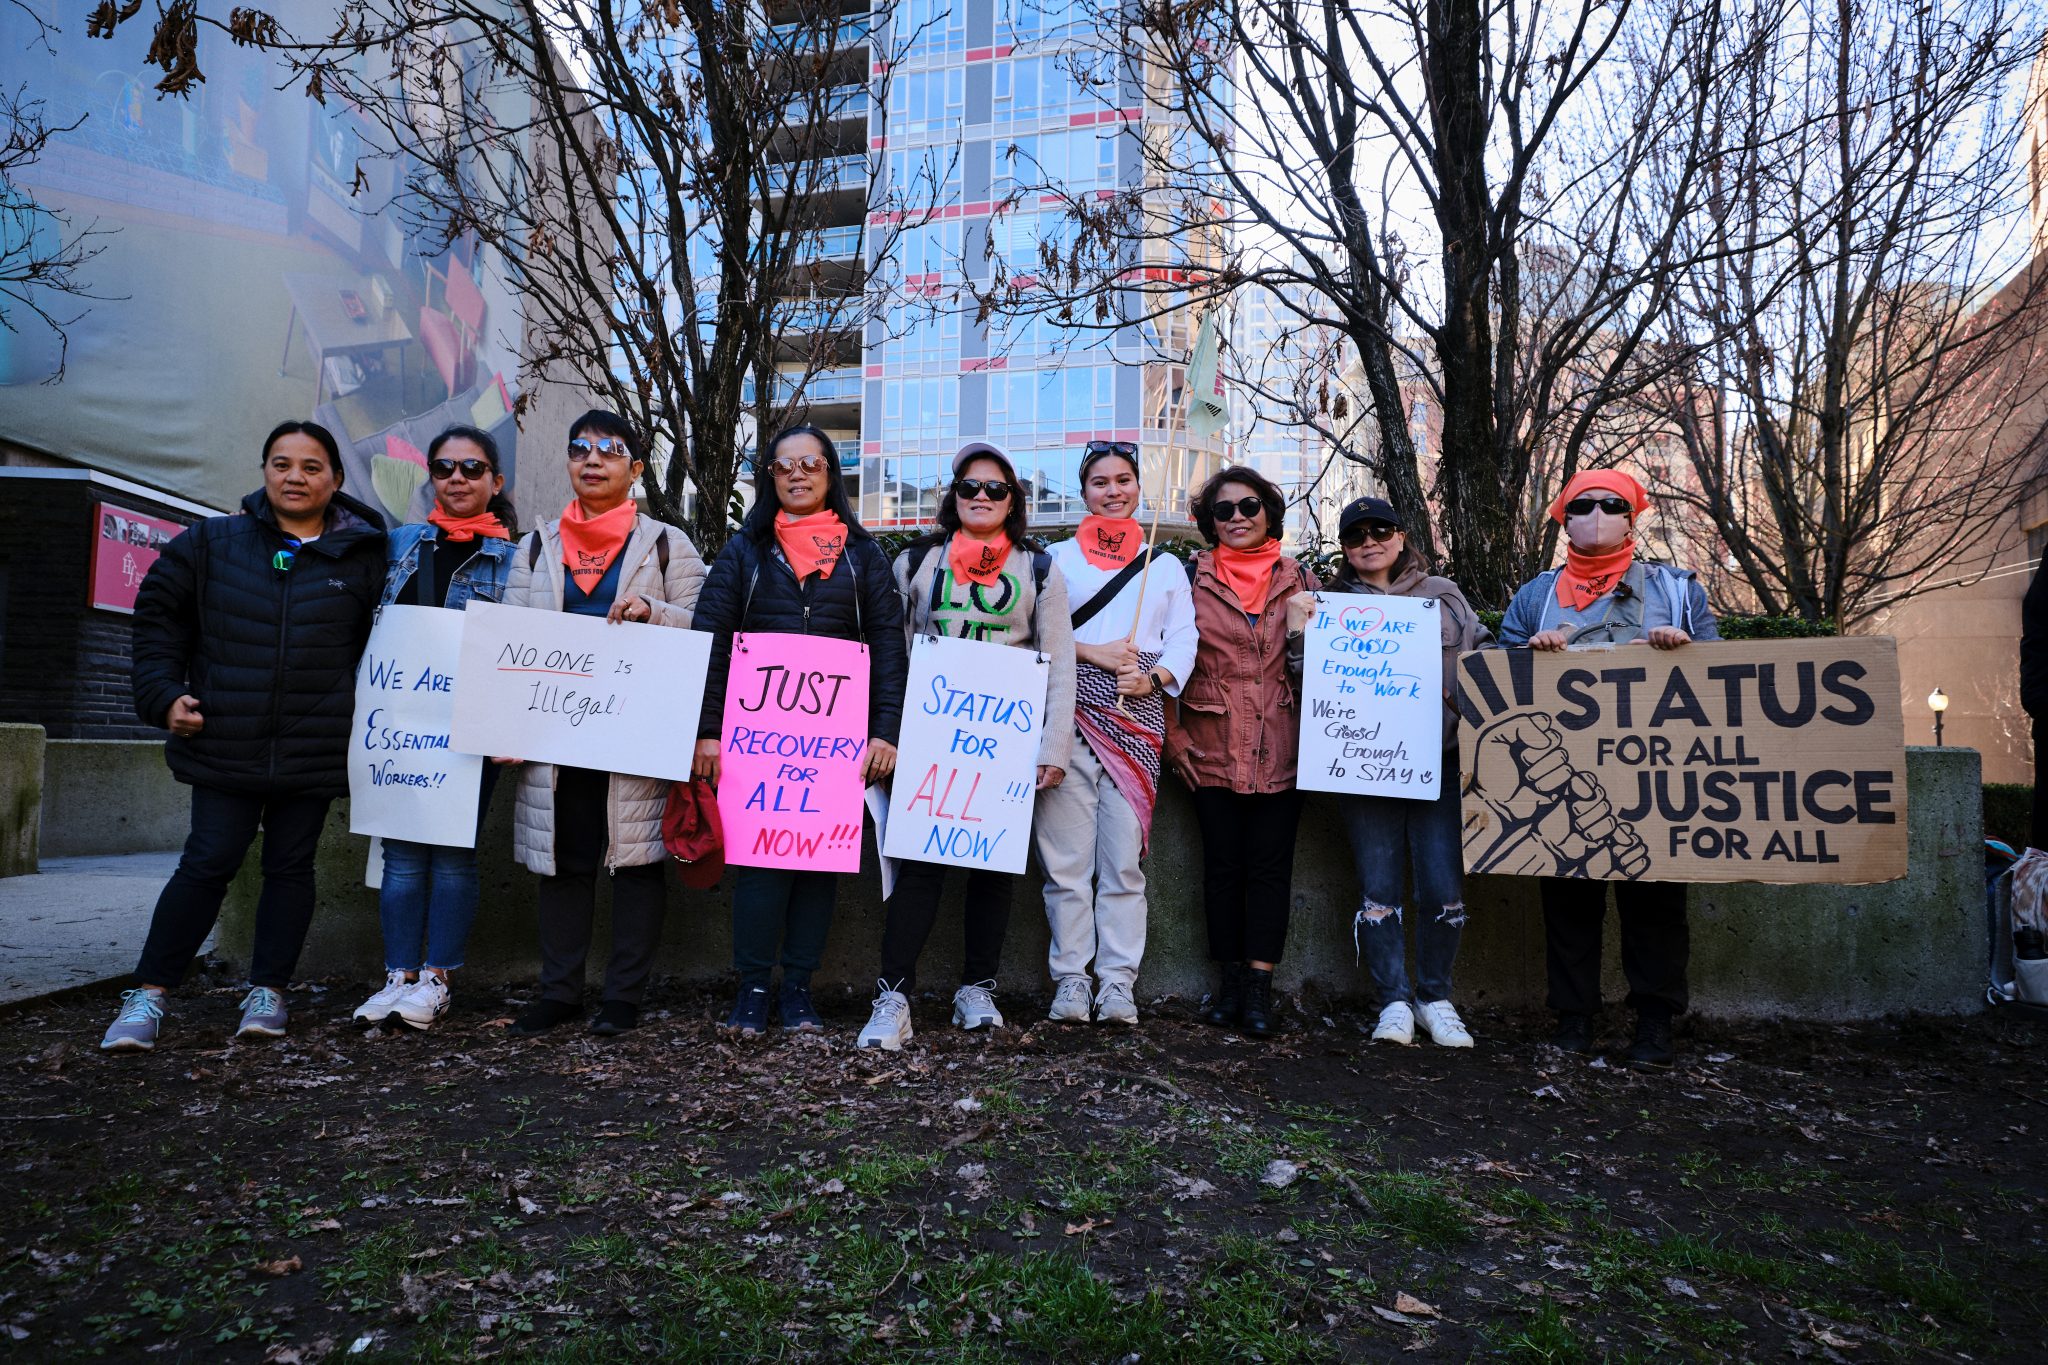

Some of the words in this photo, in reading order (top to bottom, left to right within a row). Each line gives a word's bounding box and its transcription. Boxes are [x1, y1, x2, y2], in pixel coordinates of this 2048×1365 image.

[815, 558, 834, 566] STATUS
[1089, 549, 1106, 557] STATUS
[572, 568, 592, 576] STATUS
[1314, 611, 1336, 629] IF
[1345, 619, 1374, 632] WE
[1380, 621, 1418, 633] ARE
[497, 643, 538, 667] NO
[545, 650, 595, 672] ONE
[1330, 635, 1400, 654] GOOD
[369, 654, 403, 690] WE
[413, 667, 453, 692] ARE
[1322, 659, 1421, 685] Enough
[739, 665, 851, 717] JUST
[923, 674, 1033, 733] STATUS
[1336, 680, 1355, 693] to
[1374, 681, 1421, 699] Work
[1555, 659, 1875, 731] STATUS
[1312, 698, 1356, 720] We're
[365, 708, 450, 750] ESSENTIAL
[728, 727, 865, 762] RECOVERY
[950, 728, 998, 759] FOR
[1324, 721, 1381, 741] Good
[1342, 741, 1409, 766] Enough
[1597, 735, 1674, 766] FOR
[1683, 735, 1759, 766] ALL
[777, 763, 818, 783] FOR
[1326, 758, 1346, 778] to
[1356, 763, 1413, 784] STAY
[745, 782, 821, 813] ALL
[906, 763, 982, 822] ALL
[1618, 770, 1896, 825] JUSTICE
[752, 824, 860, 858] NOW!!!
[924, 825, 1006, 862] NOW
[1669, 825, 1752, 861] FOR
[1762, 829, 1839, 864] ALL
